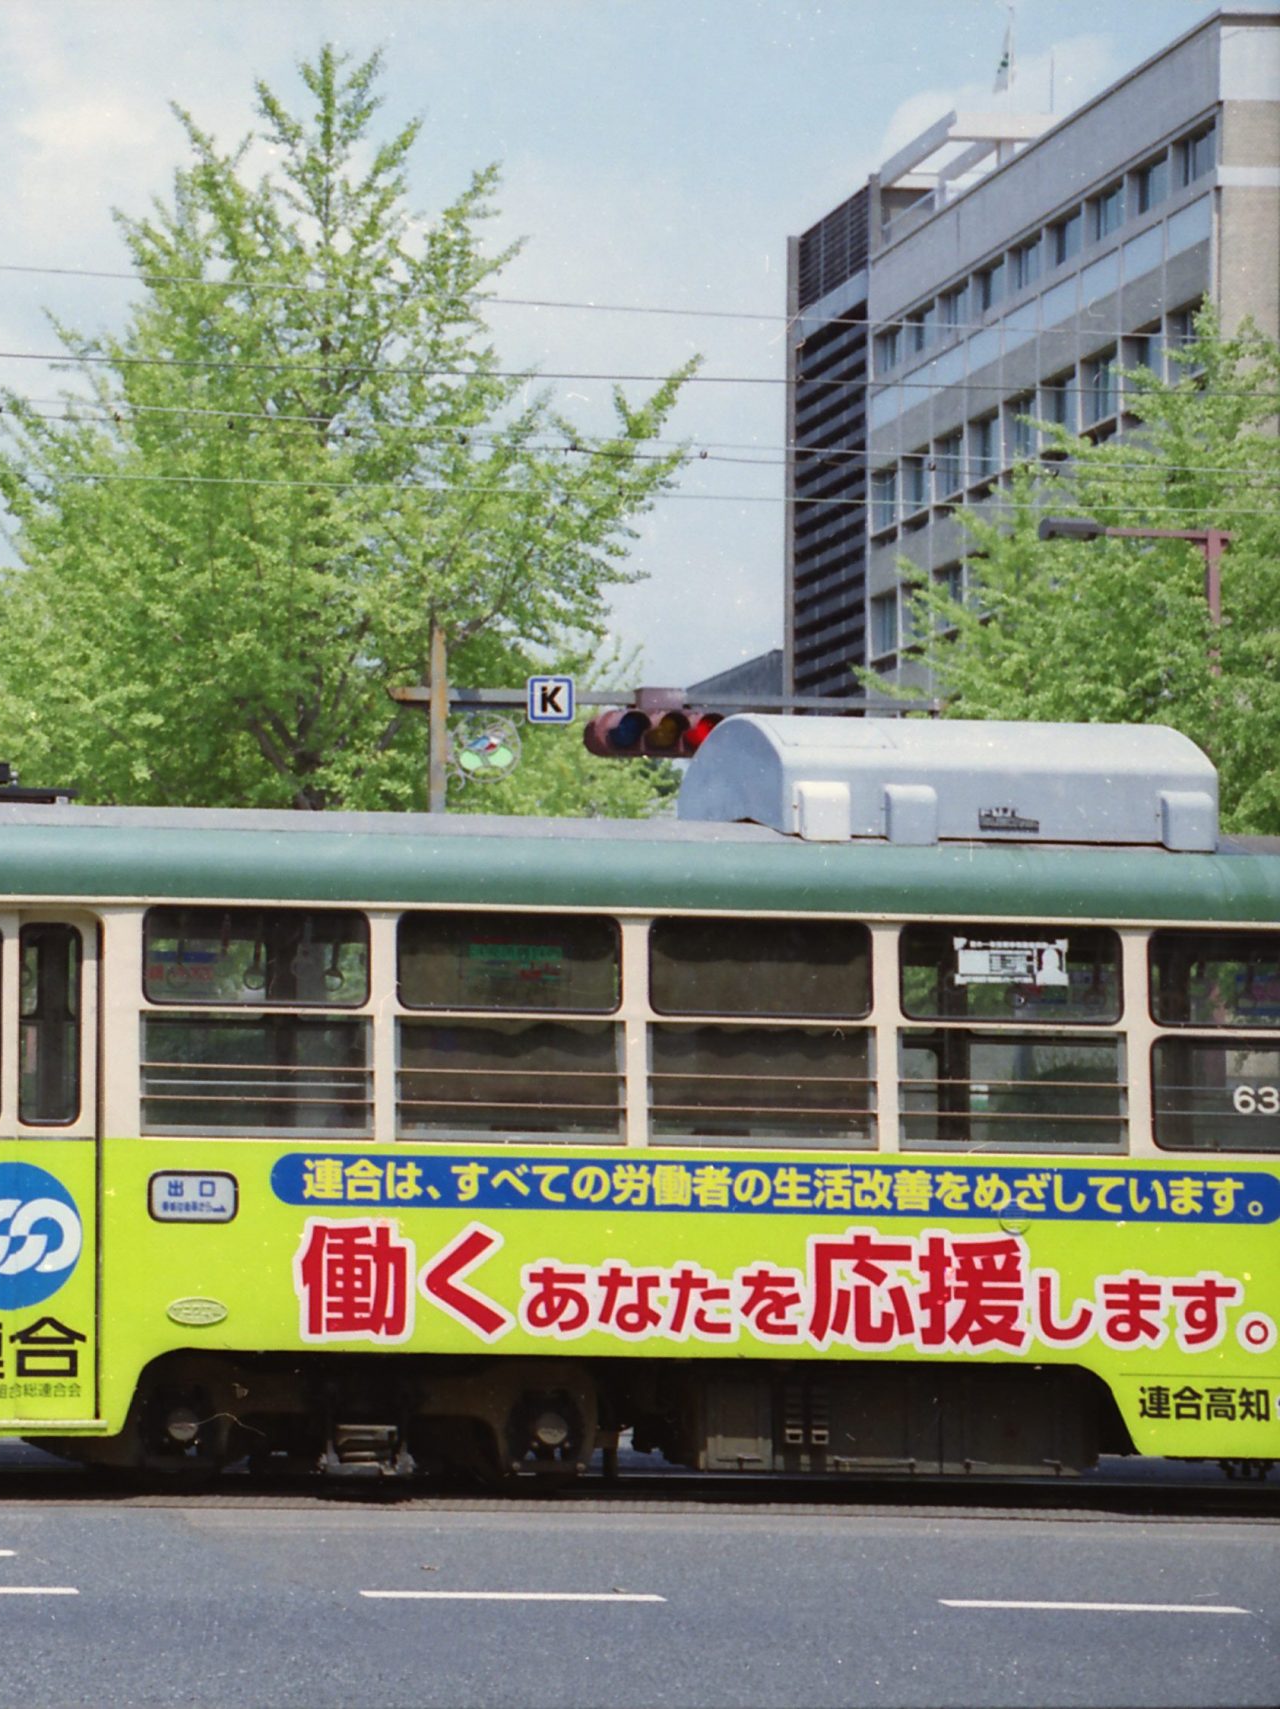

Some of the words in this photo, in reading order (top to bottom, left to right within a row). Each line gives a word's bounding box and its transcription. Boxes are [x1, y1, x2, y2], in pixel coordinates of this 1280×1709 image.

[540, 685, 562, 714] K
[168, 1179, 216, 1198] 出口
[302, 1158, 1265, 1217] 連合は、すべての労働者の生活改善をめざしています。
[298, 1221, 1272, 1350] 働くあなたを応援します。
[1138, 1386, 1270, 1422] 連合高知
